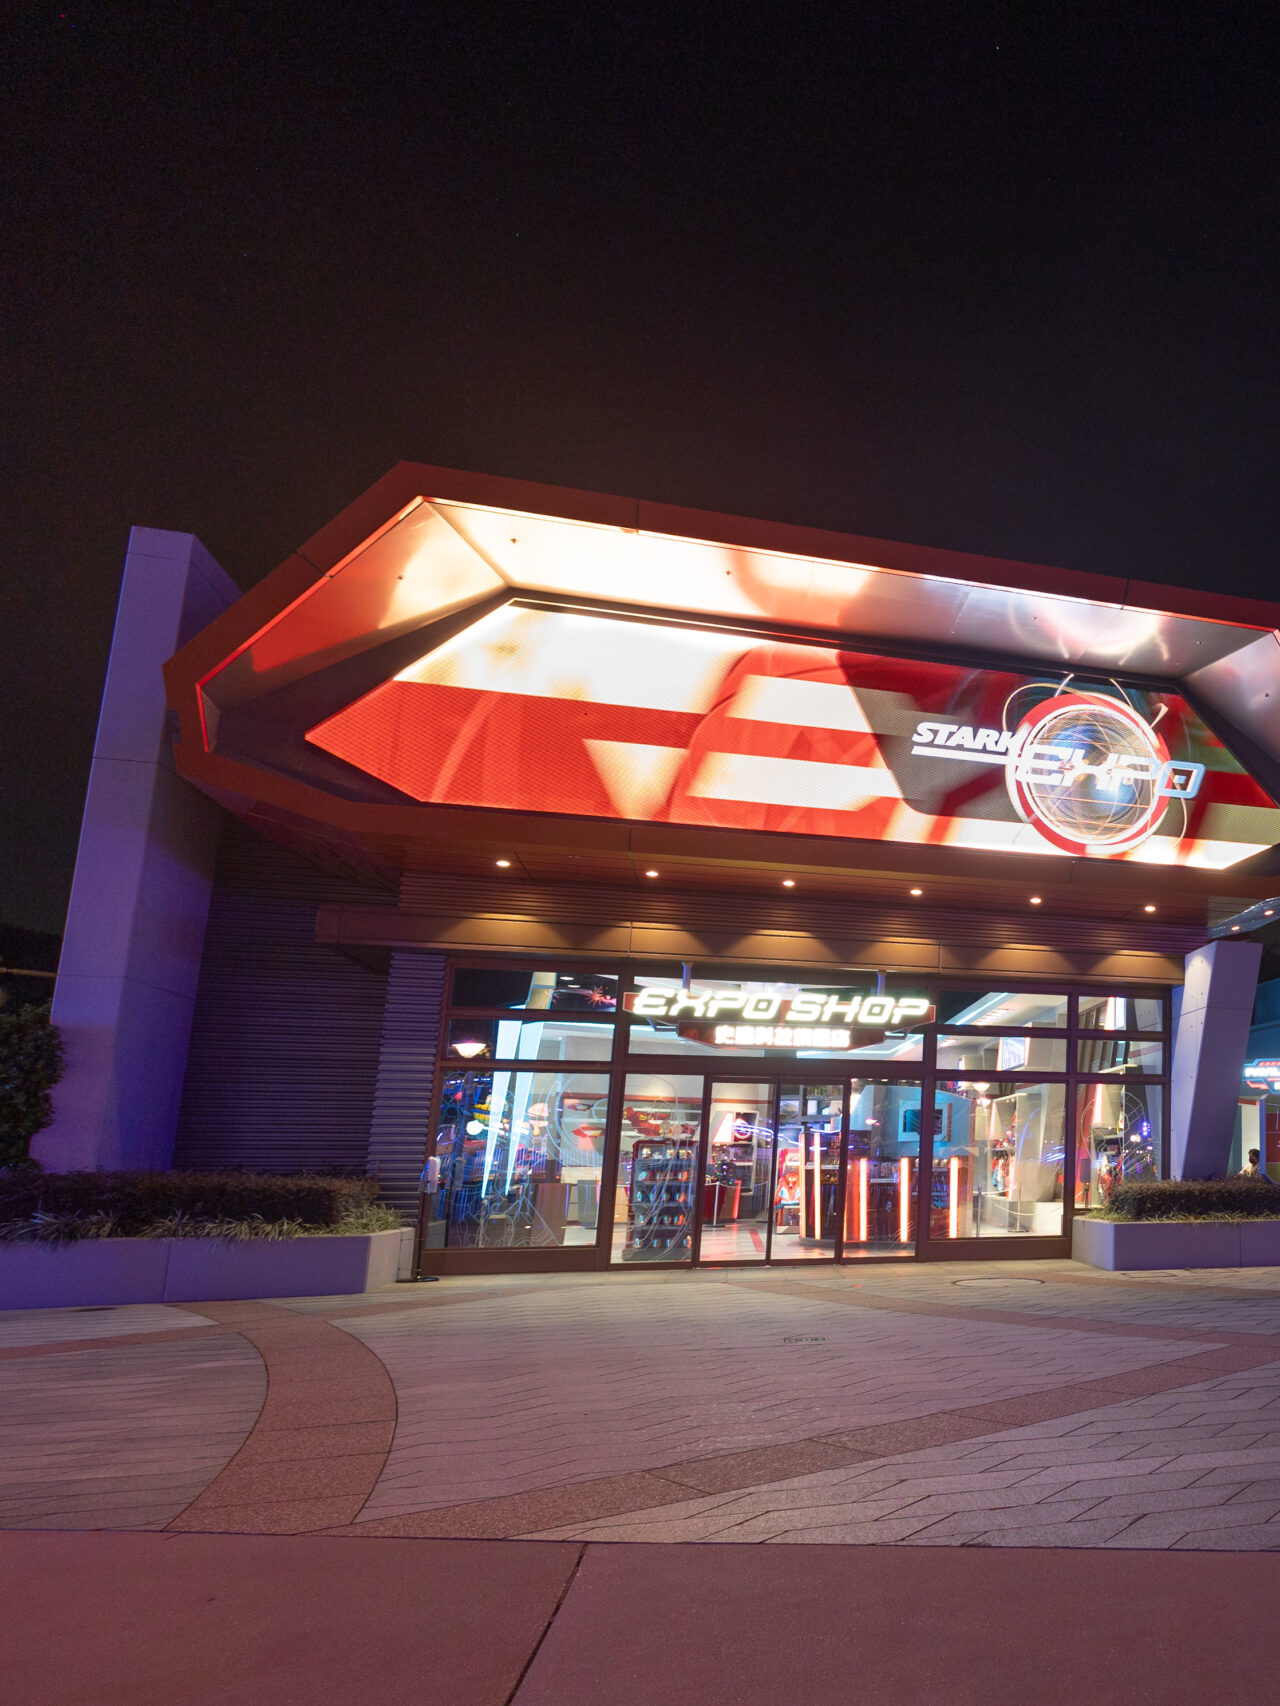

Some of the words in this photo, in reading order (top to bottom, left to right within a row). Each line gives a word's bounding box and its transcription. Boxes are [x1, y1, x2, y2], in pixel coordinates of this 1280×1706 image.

[911, 721, 1019, 753] STARK
[1015, 744, 1206, 799] EXPO
[633, 987, 784, 1019] EXPO
[785, 991, 931, 1024] SHOP
